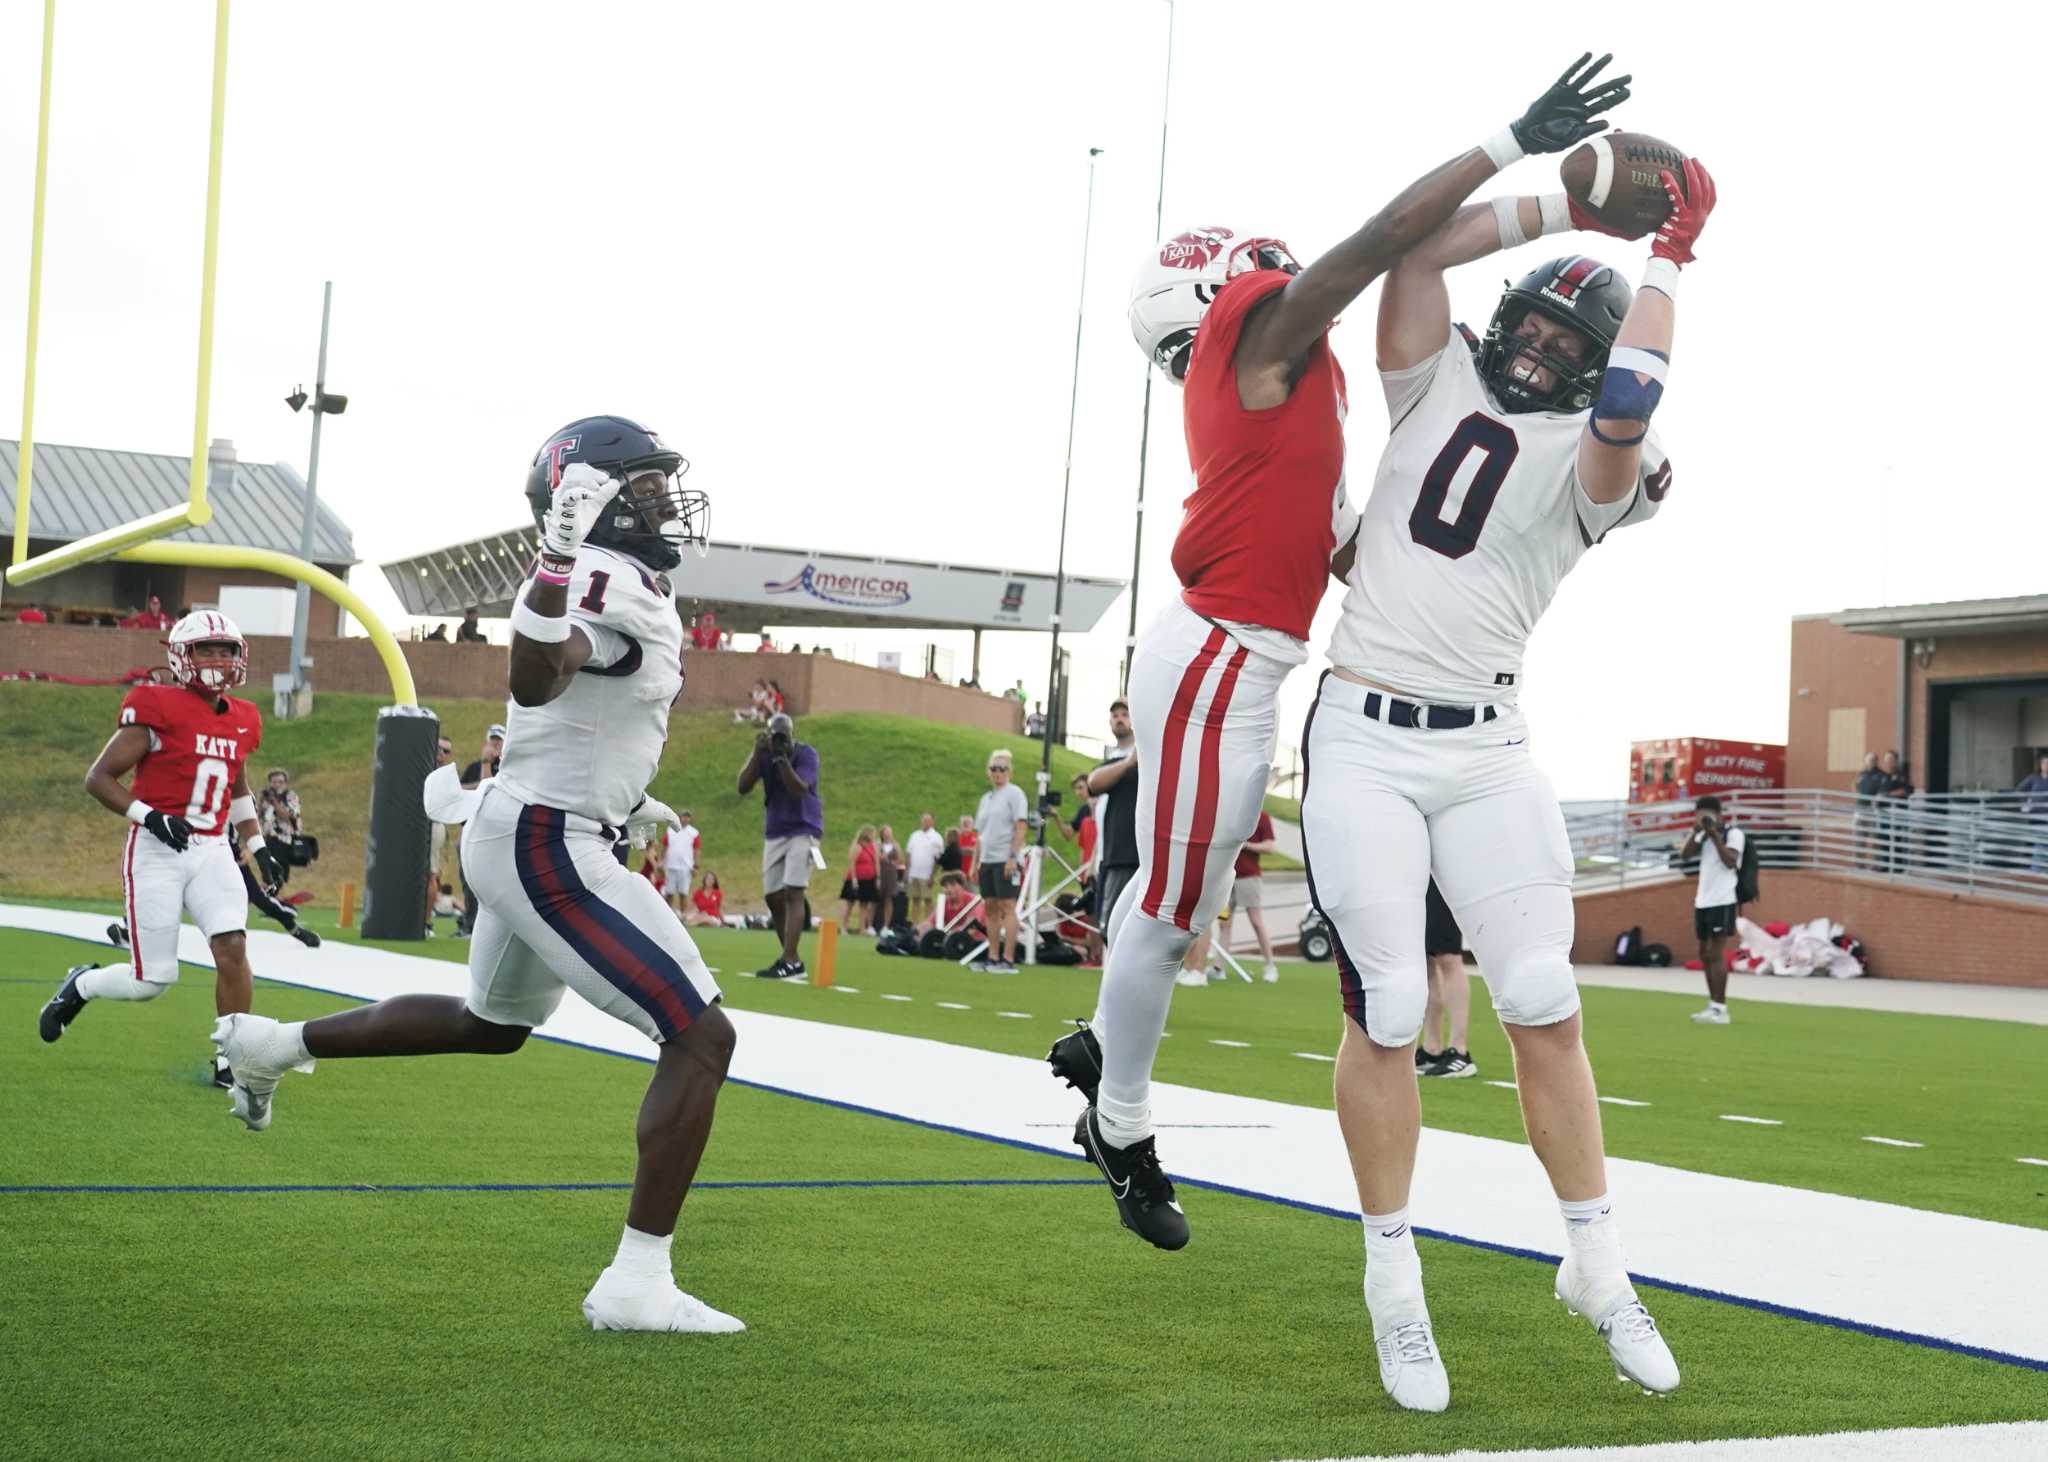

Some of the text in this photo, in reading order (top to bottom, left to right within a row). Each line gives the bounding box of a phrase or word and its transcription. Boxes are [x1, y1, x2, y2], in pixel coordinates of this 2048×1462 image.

[1540, 286, 1577, 309] Riddell
[1408, 411, 1519, 560] 0
[578, 569, 611, 615] 1
[195, 733, 238, 760] KATY
[1704, 754, 1766, 773] KATY FIRE
[1694, 771, 1775, 789] DEPARTMENT
[184, 757, 229, 831] 0
